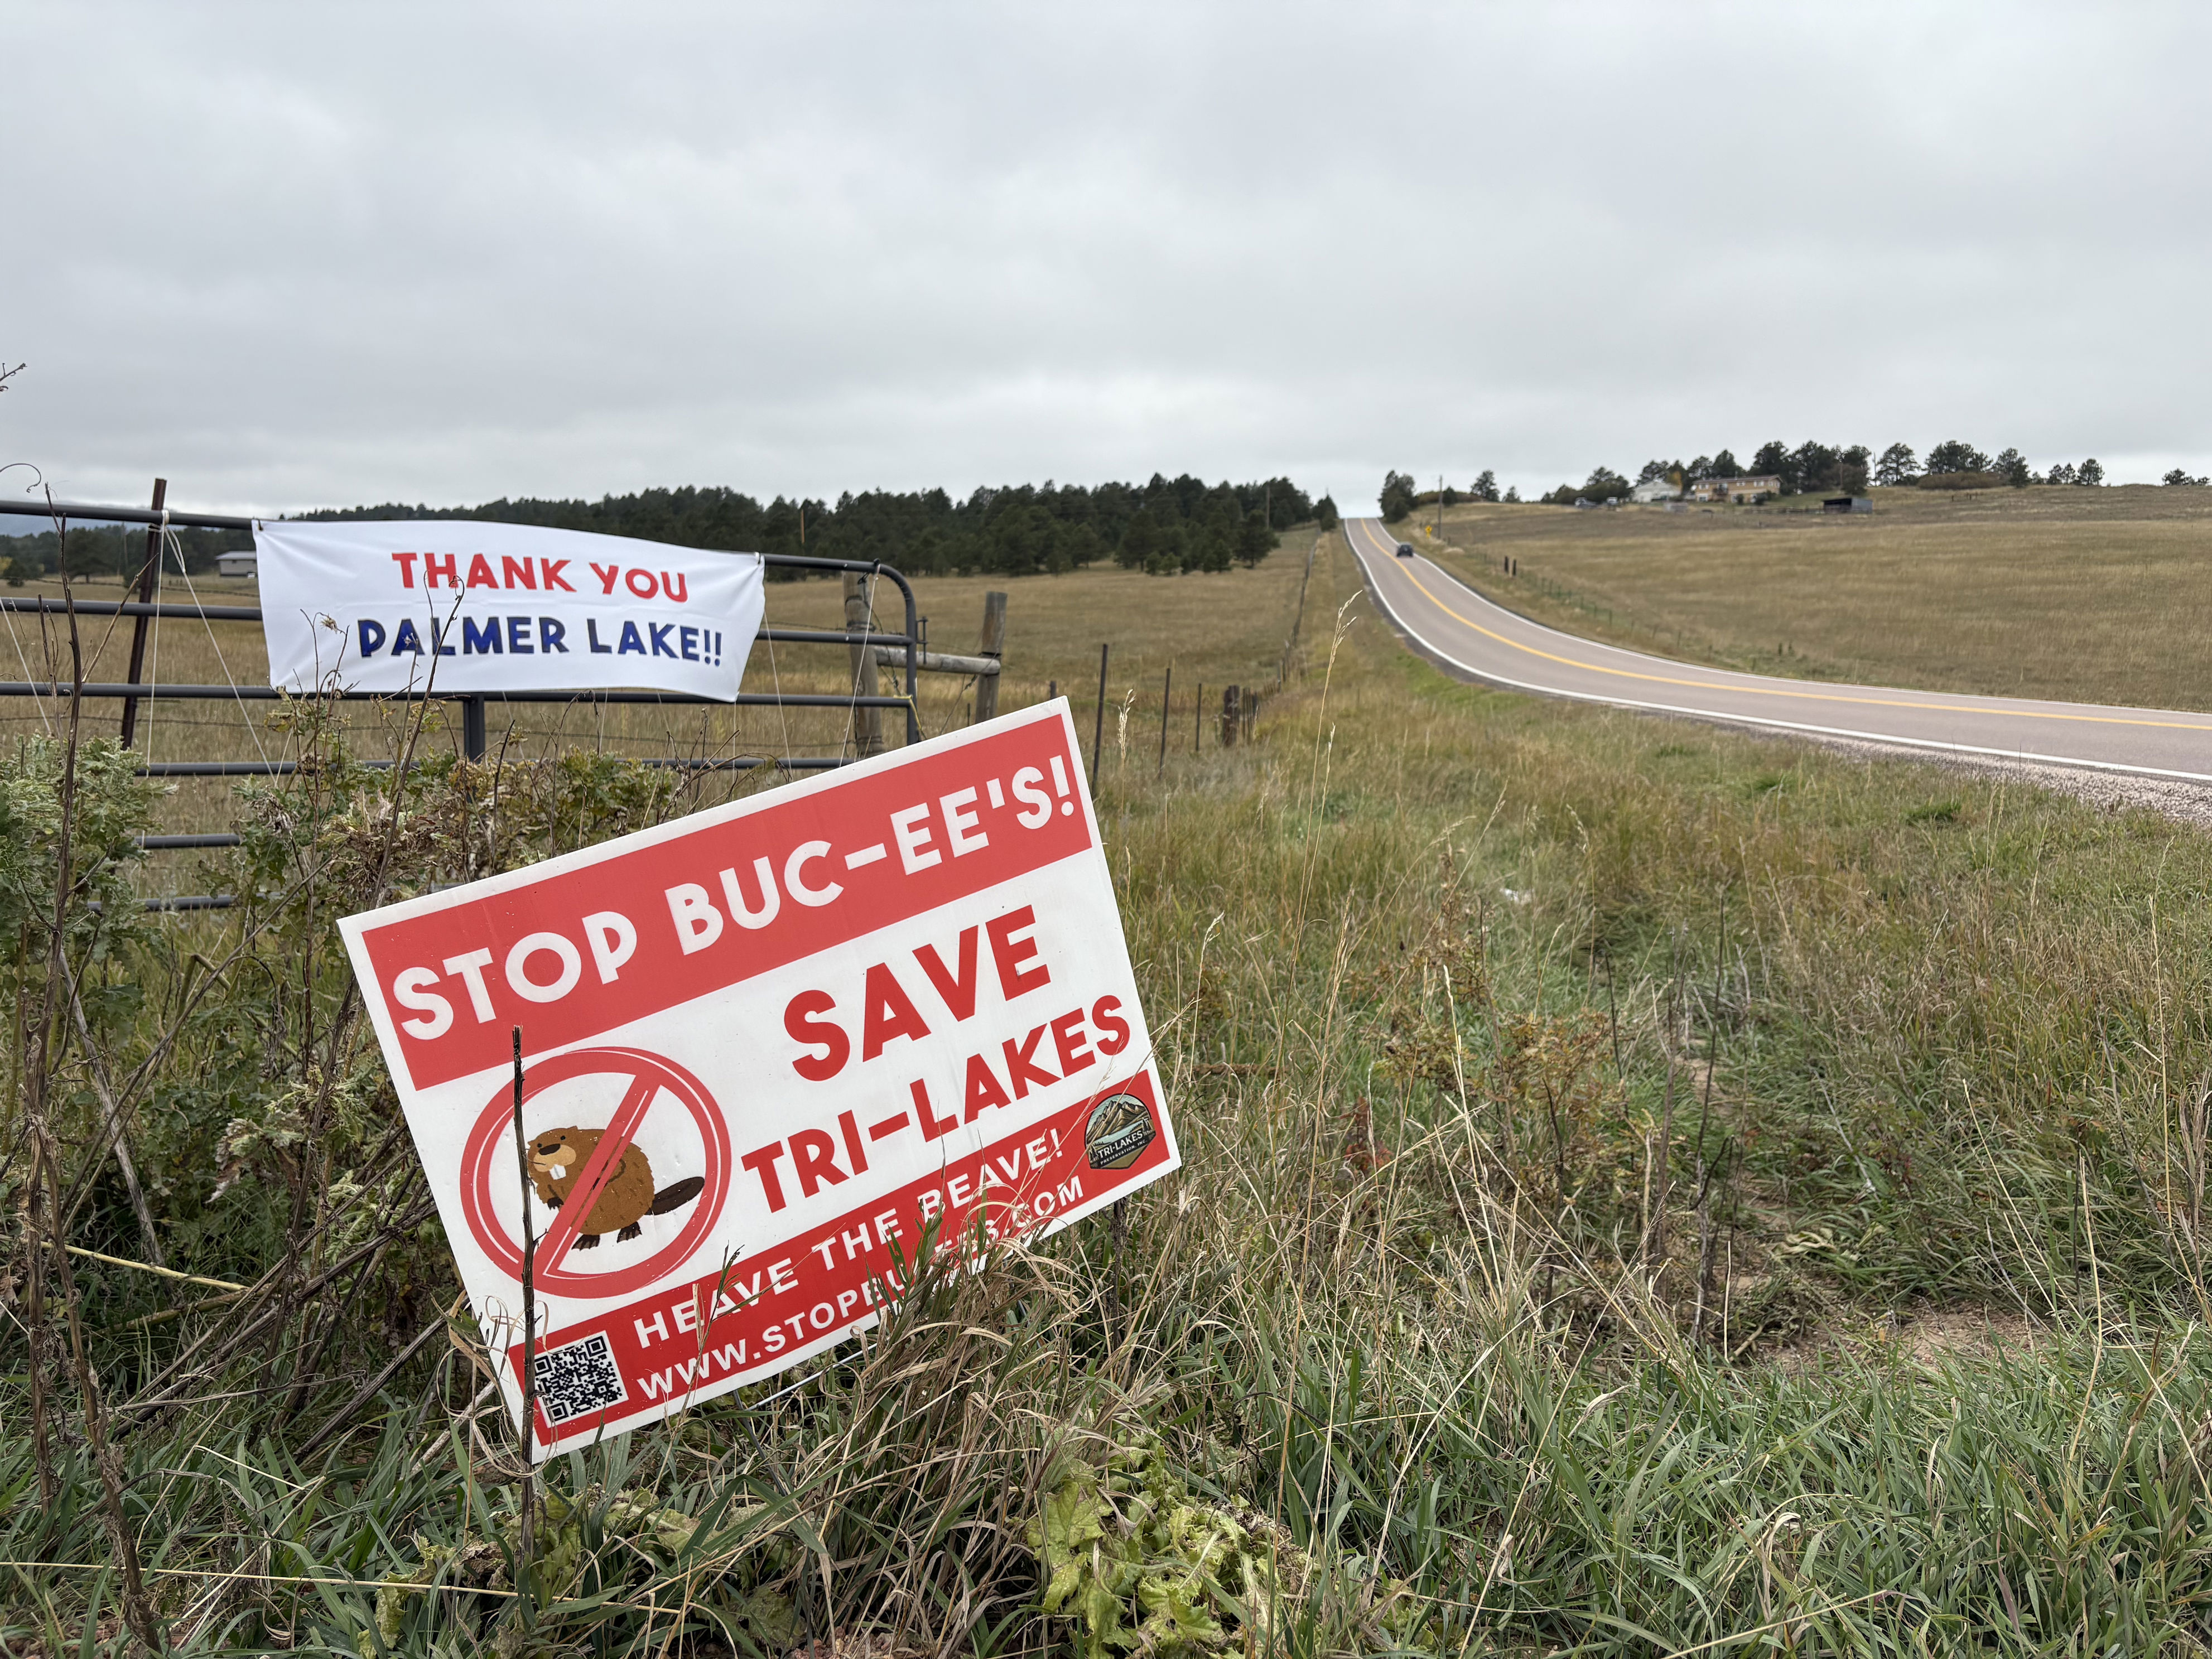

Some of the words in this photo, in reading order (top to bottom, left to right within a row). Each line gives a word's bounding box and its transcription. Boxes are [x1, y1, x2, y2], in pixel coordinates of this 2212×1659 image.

[358, 616, 570, 658] PALMER
[587, 618, 722, 667] LAKE!!
[392, 553, 576, 592] THANK
[589, 562, 688, 603] YOU
[392, 911, 637, 1040] STOP
[665, 754, 1076, 956] BUC-EE'S!
[784, 904, 1051, 1082] SAVE
[741, 995, 1130, 1213] TRI-LAKES
[1098, 1130, 1143, 1159] TRI-LAKES
[634, 1257, 798, 1349] HEAVE
[812, 1208, 903, 1271] THE
[917, 1128, 1064, 1225] BEAVE!
